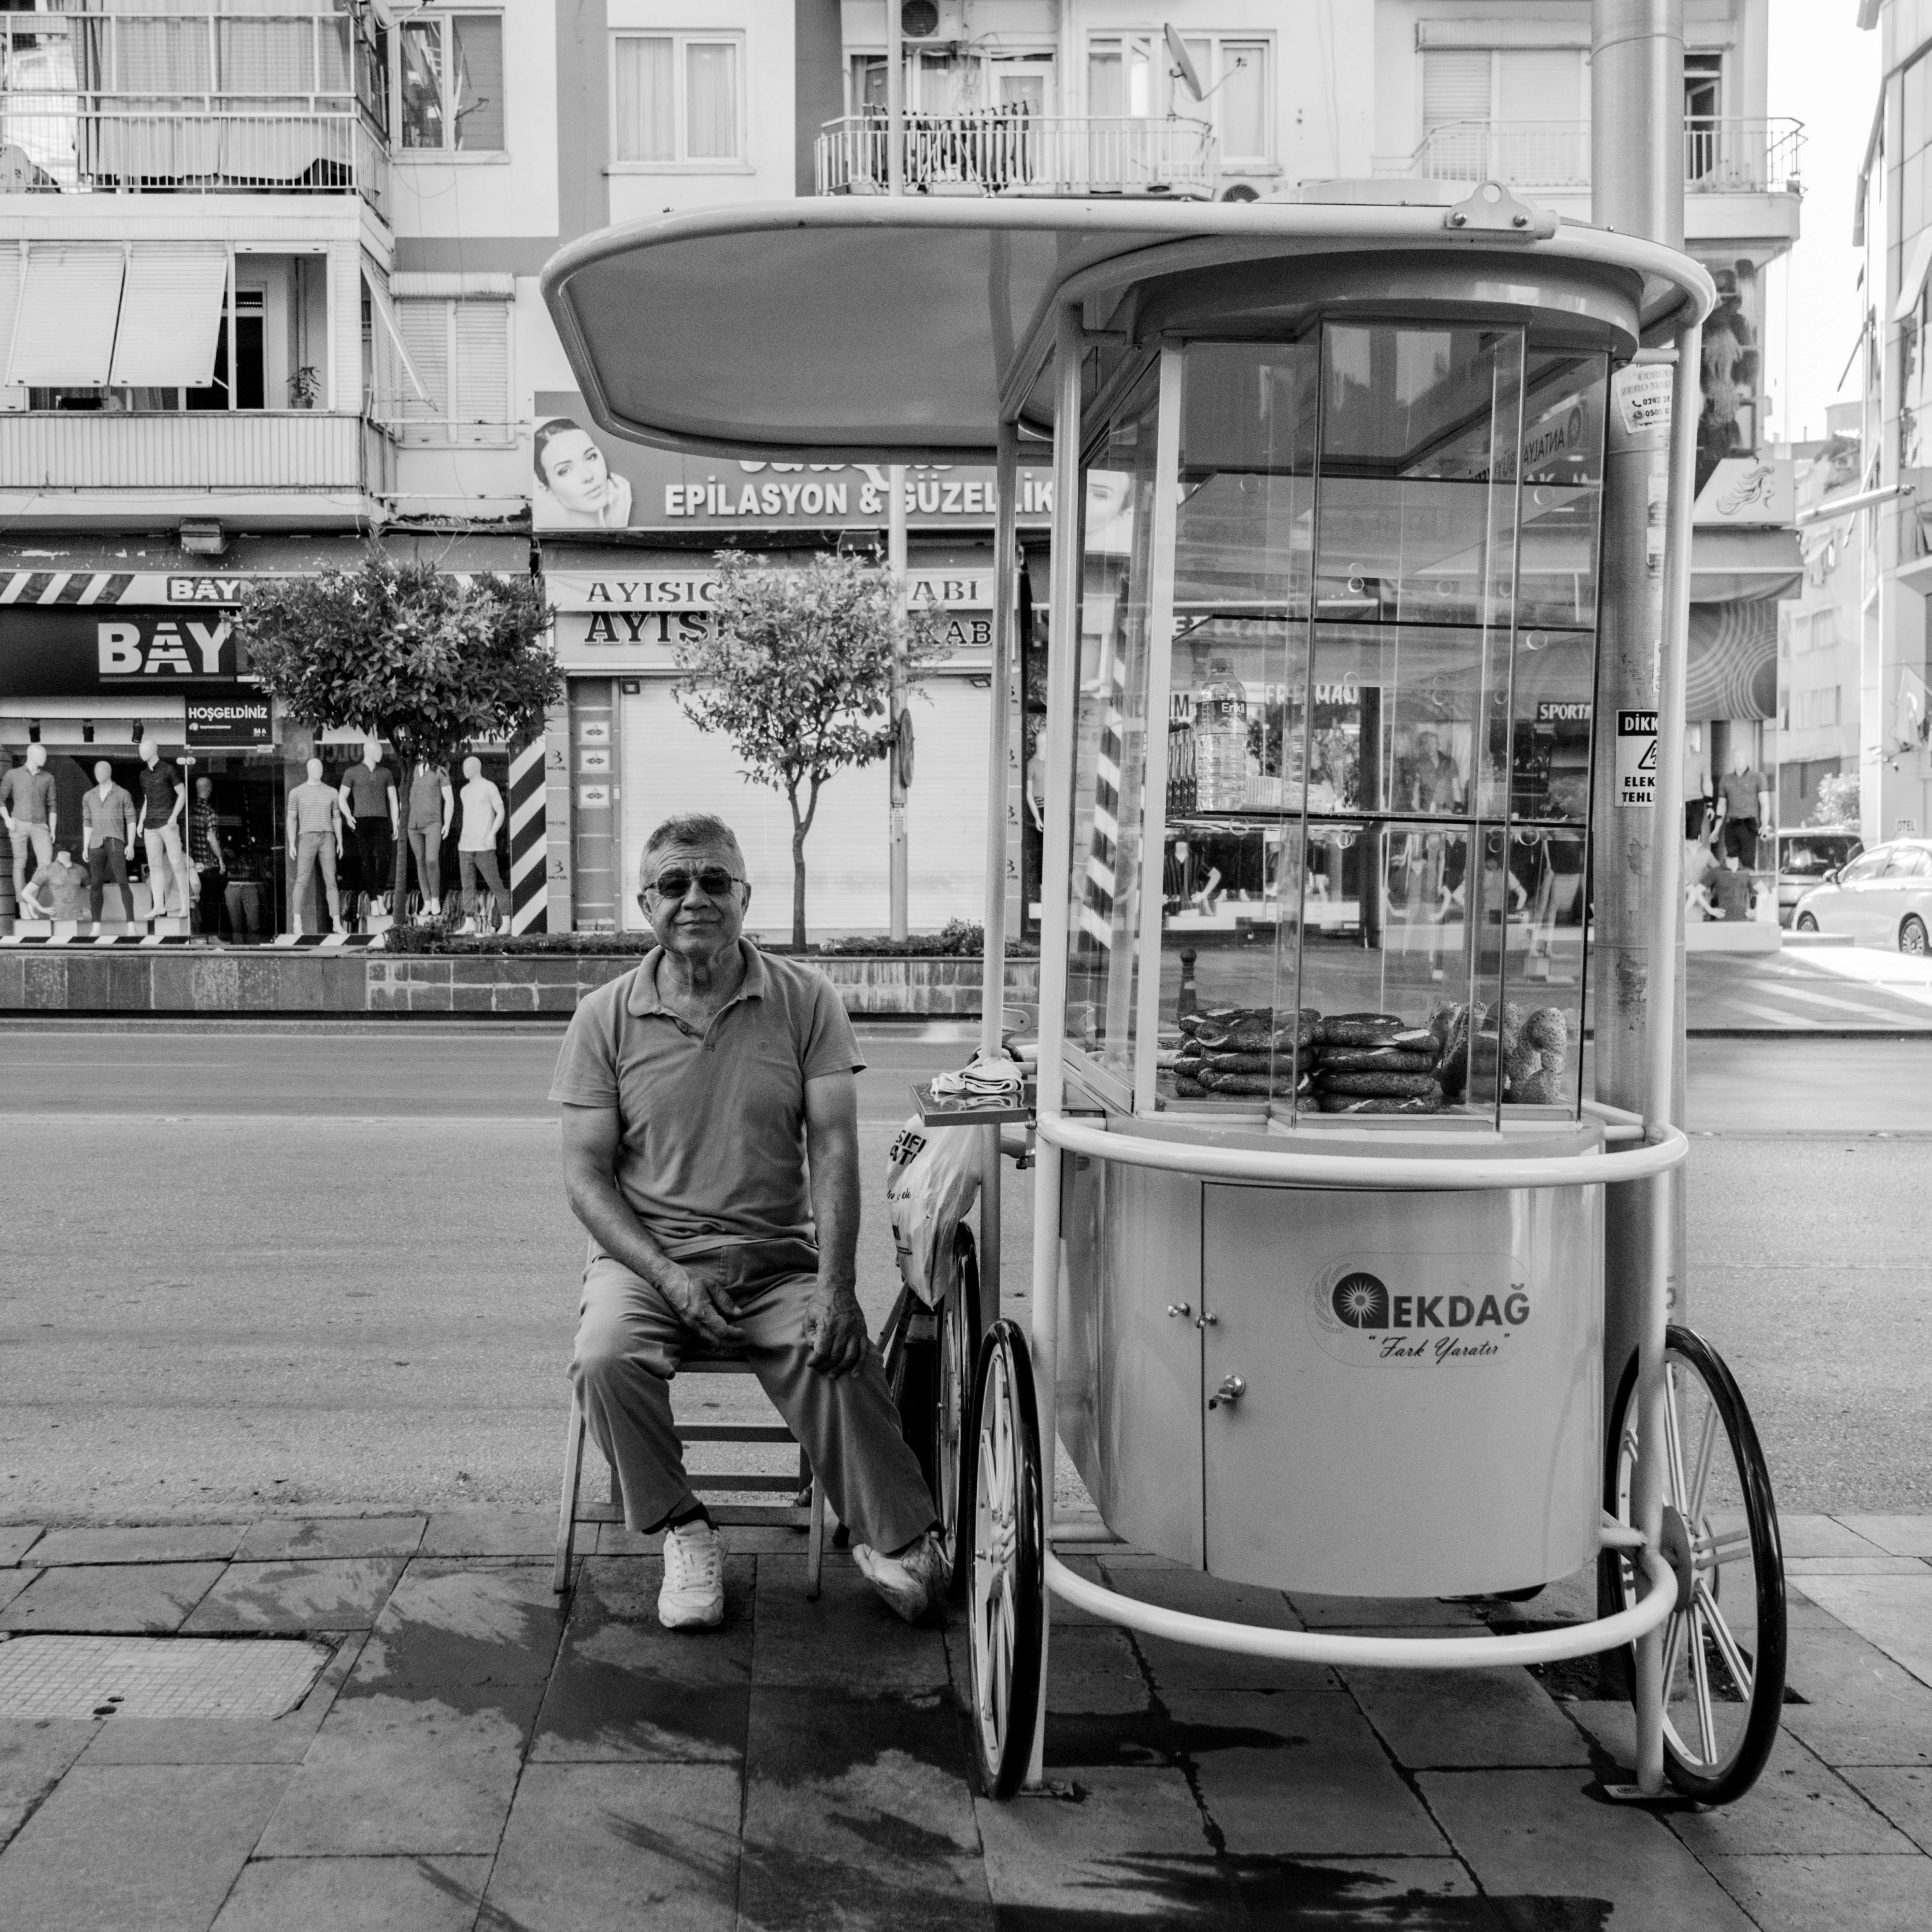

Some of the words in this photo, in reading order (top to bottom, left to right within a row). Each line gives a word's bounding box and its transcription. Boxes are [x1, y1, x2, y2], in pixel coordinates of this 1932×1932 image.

[665, 475, 847, 515] EPİLASYON
[859, 482, 882, 513] &
[171, 580, 240, 600] BAY
[98, 623, 232, 673] BAY
[188, 704, 268, 722] HOŞGELDİNİZ
[1222, 701, 1246, 714] Erikli
[1621, 792, 1655, 802] TEHL
[1393, 1283, 1530, 1328] EKDAĞ
